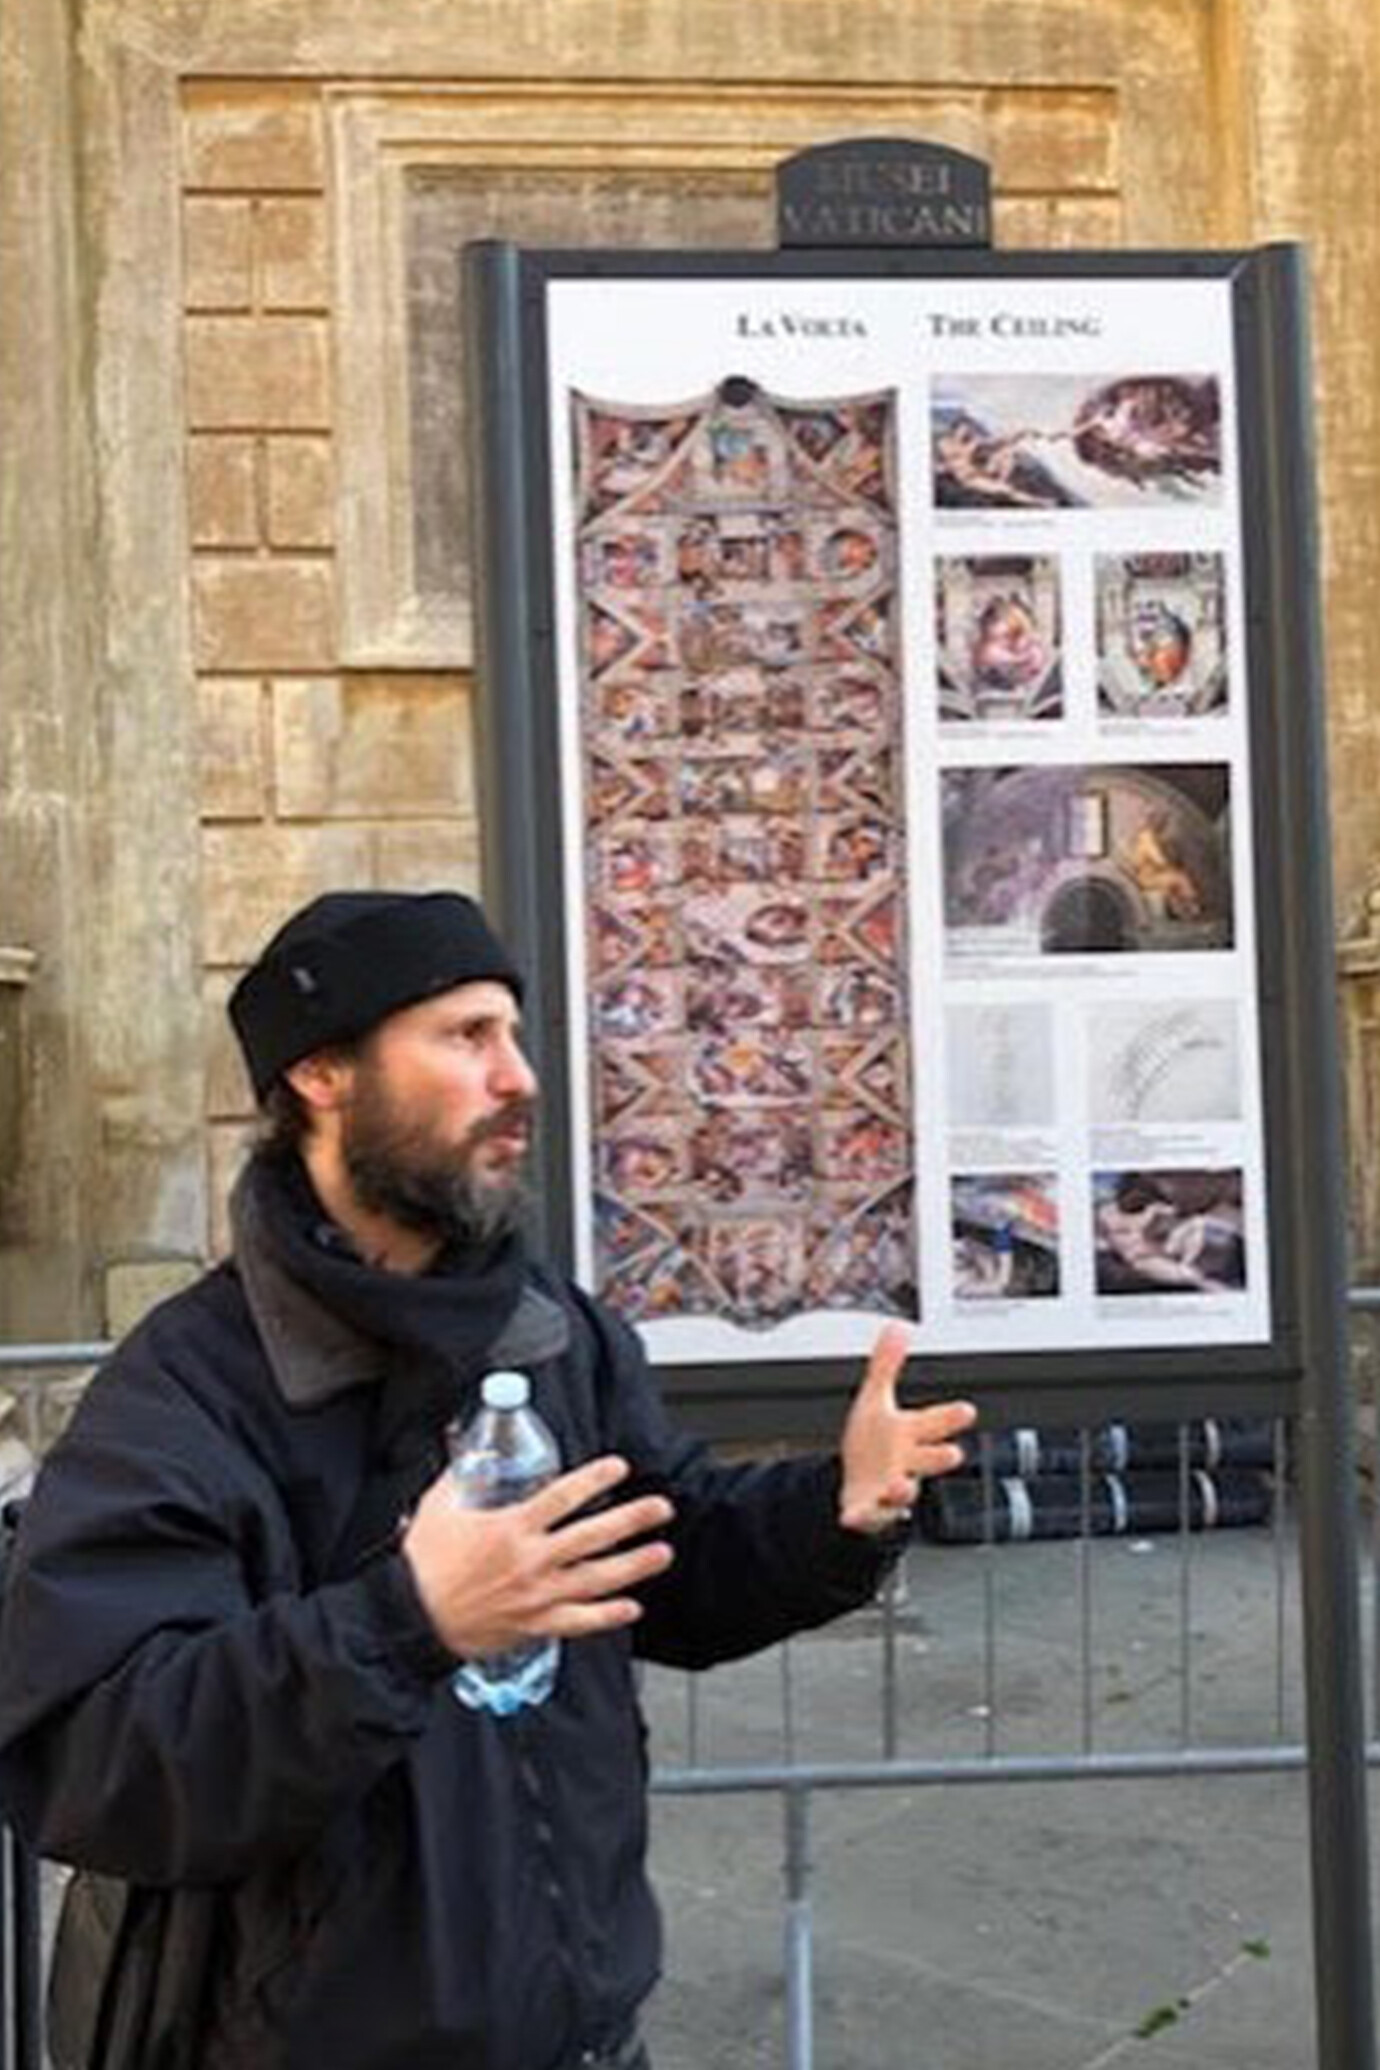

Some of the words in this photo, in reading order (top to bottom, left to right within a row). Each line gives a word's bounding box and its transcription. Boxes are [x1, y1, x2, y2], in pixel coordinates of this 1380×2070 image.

[736, 313, 775, 338] LA
[928, 313, 981, 338] THE
[989, 312, 1101, 338] CEILING
